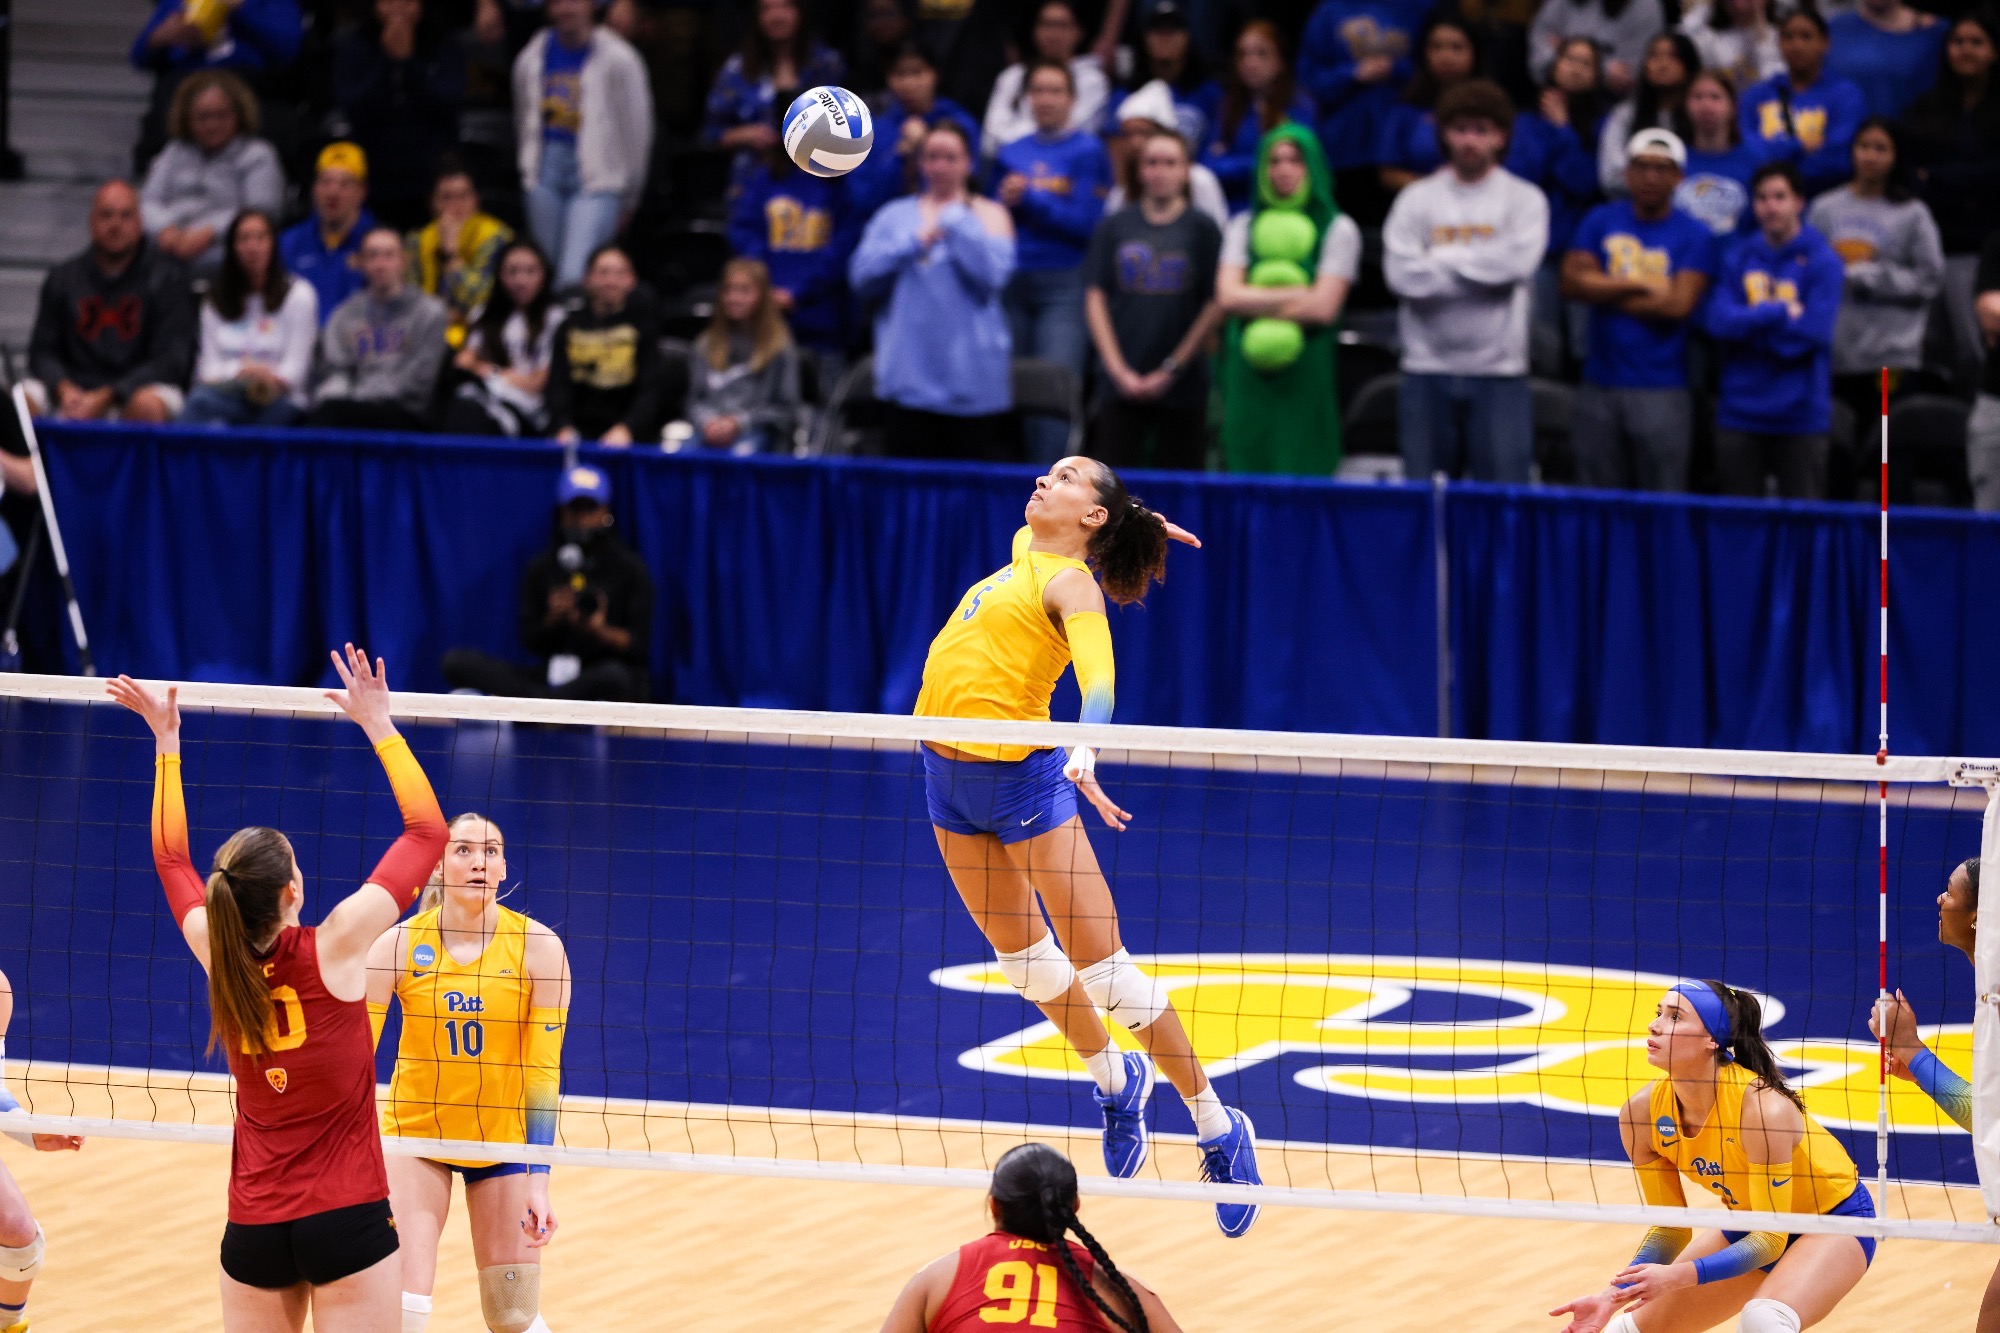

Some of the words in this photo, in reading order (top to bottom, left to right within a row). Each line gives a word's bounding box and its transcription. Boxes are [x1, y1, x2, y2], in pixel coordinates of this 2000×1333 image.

[963, 585, 993, 621] 5
[415, 953, 434, 962] NCAA
[443, 992, 485, 1013] Pitt
[444, 1020, 484, 1058] 10
[1659, 1125, 1676, 1133] NCAA
[1690, 1157, 1725, 1177] Pitt
[978, 1260, 1058, 1329] 91
